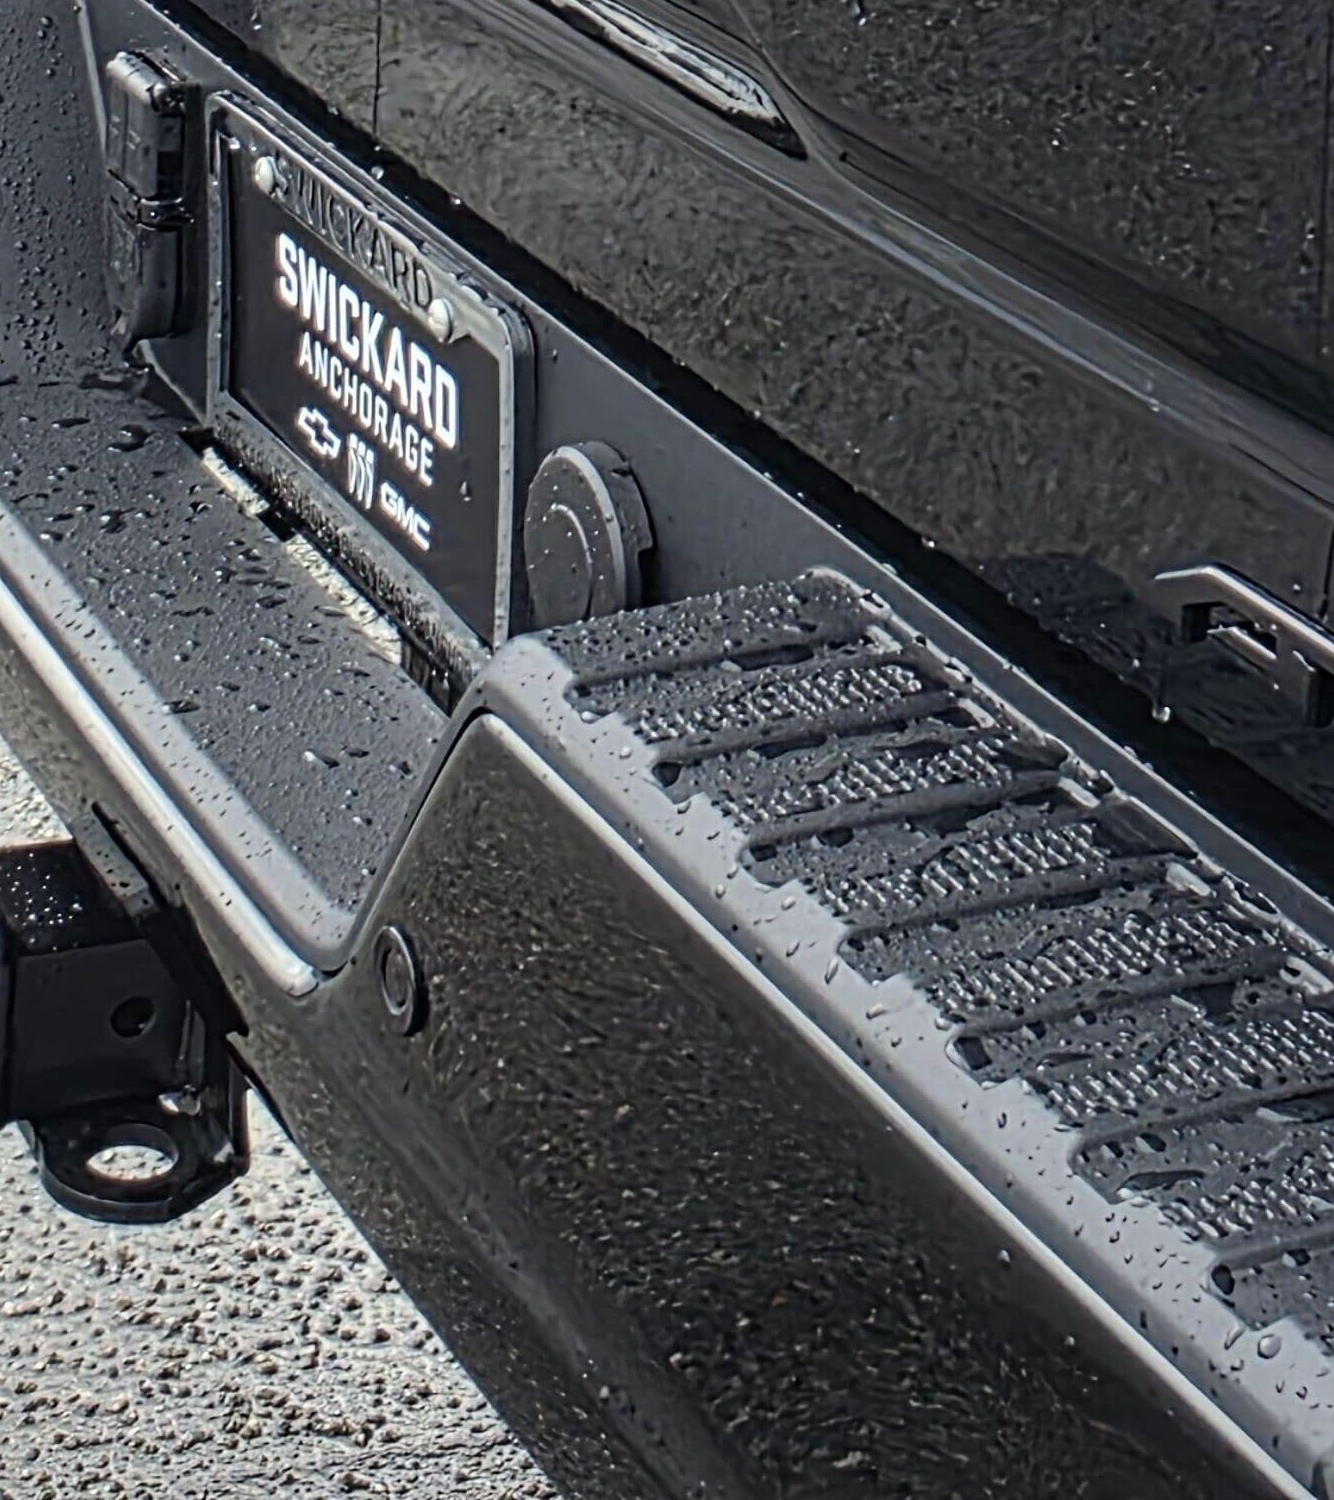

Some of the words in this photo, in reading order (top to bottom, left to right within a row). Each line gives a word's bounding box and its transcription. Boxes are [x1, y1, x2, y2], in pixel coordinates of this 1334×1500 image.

[276, 232, 459, 450] SWICKARD
[299, 332, 434, 487] ANCHORAGE
[380, 481, 431, 551] GMC
